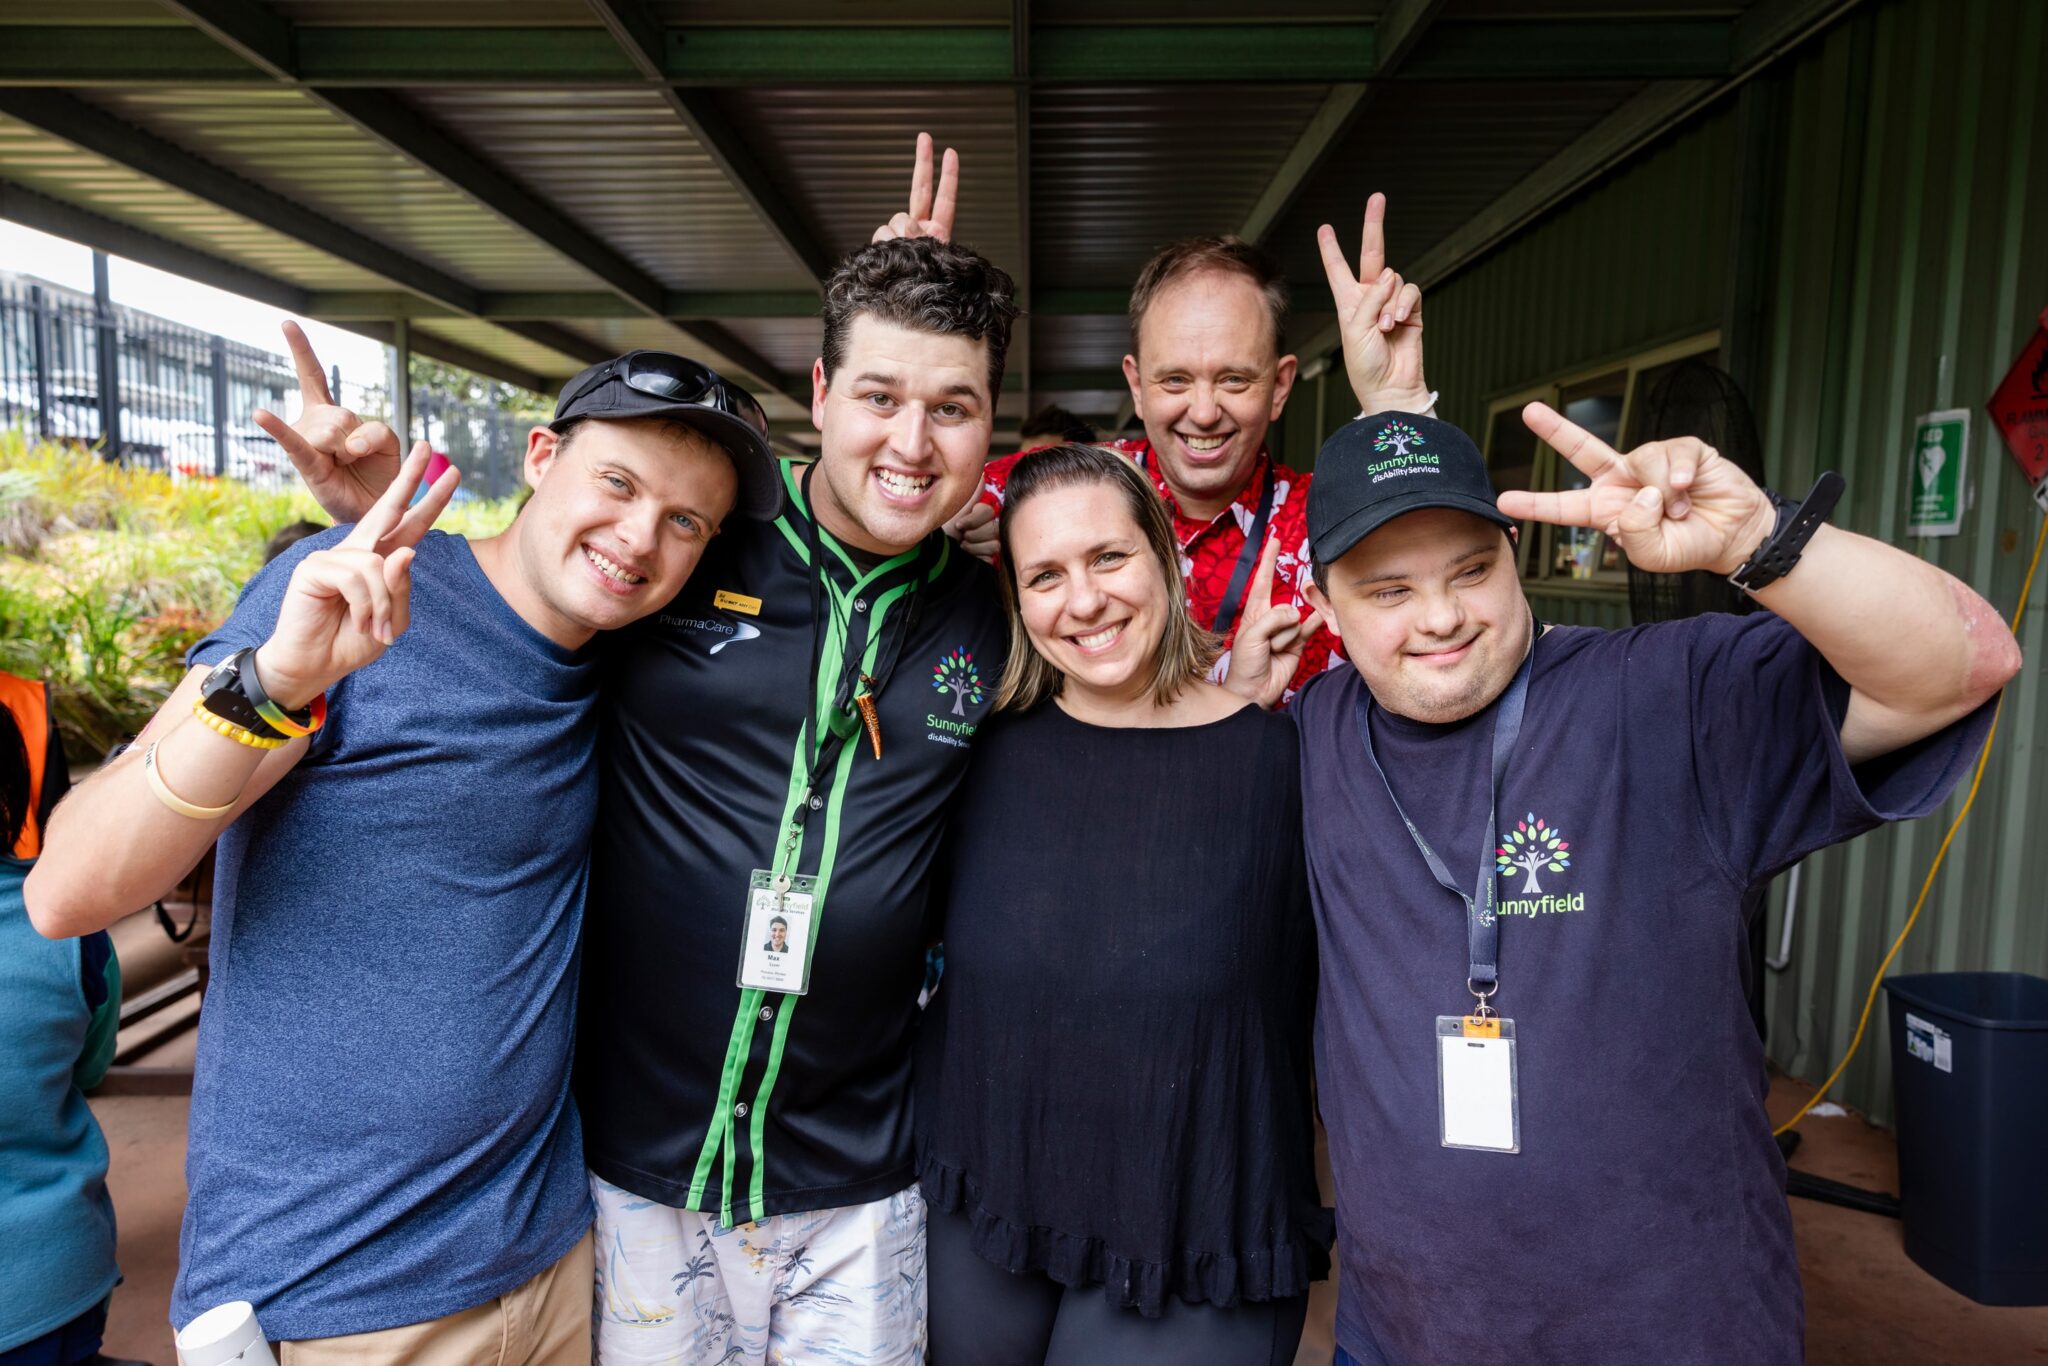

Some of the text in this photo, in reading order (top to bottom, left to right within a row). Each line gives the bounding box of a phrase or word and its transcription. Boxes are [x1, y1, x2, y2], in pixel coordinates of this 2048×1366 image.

[1367, 453, 1440, 475] Sunnyfield
[659, 615, 734, 634] PharmaCare
[1496, 892, 1584, 918] unnyfield
